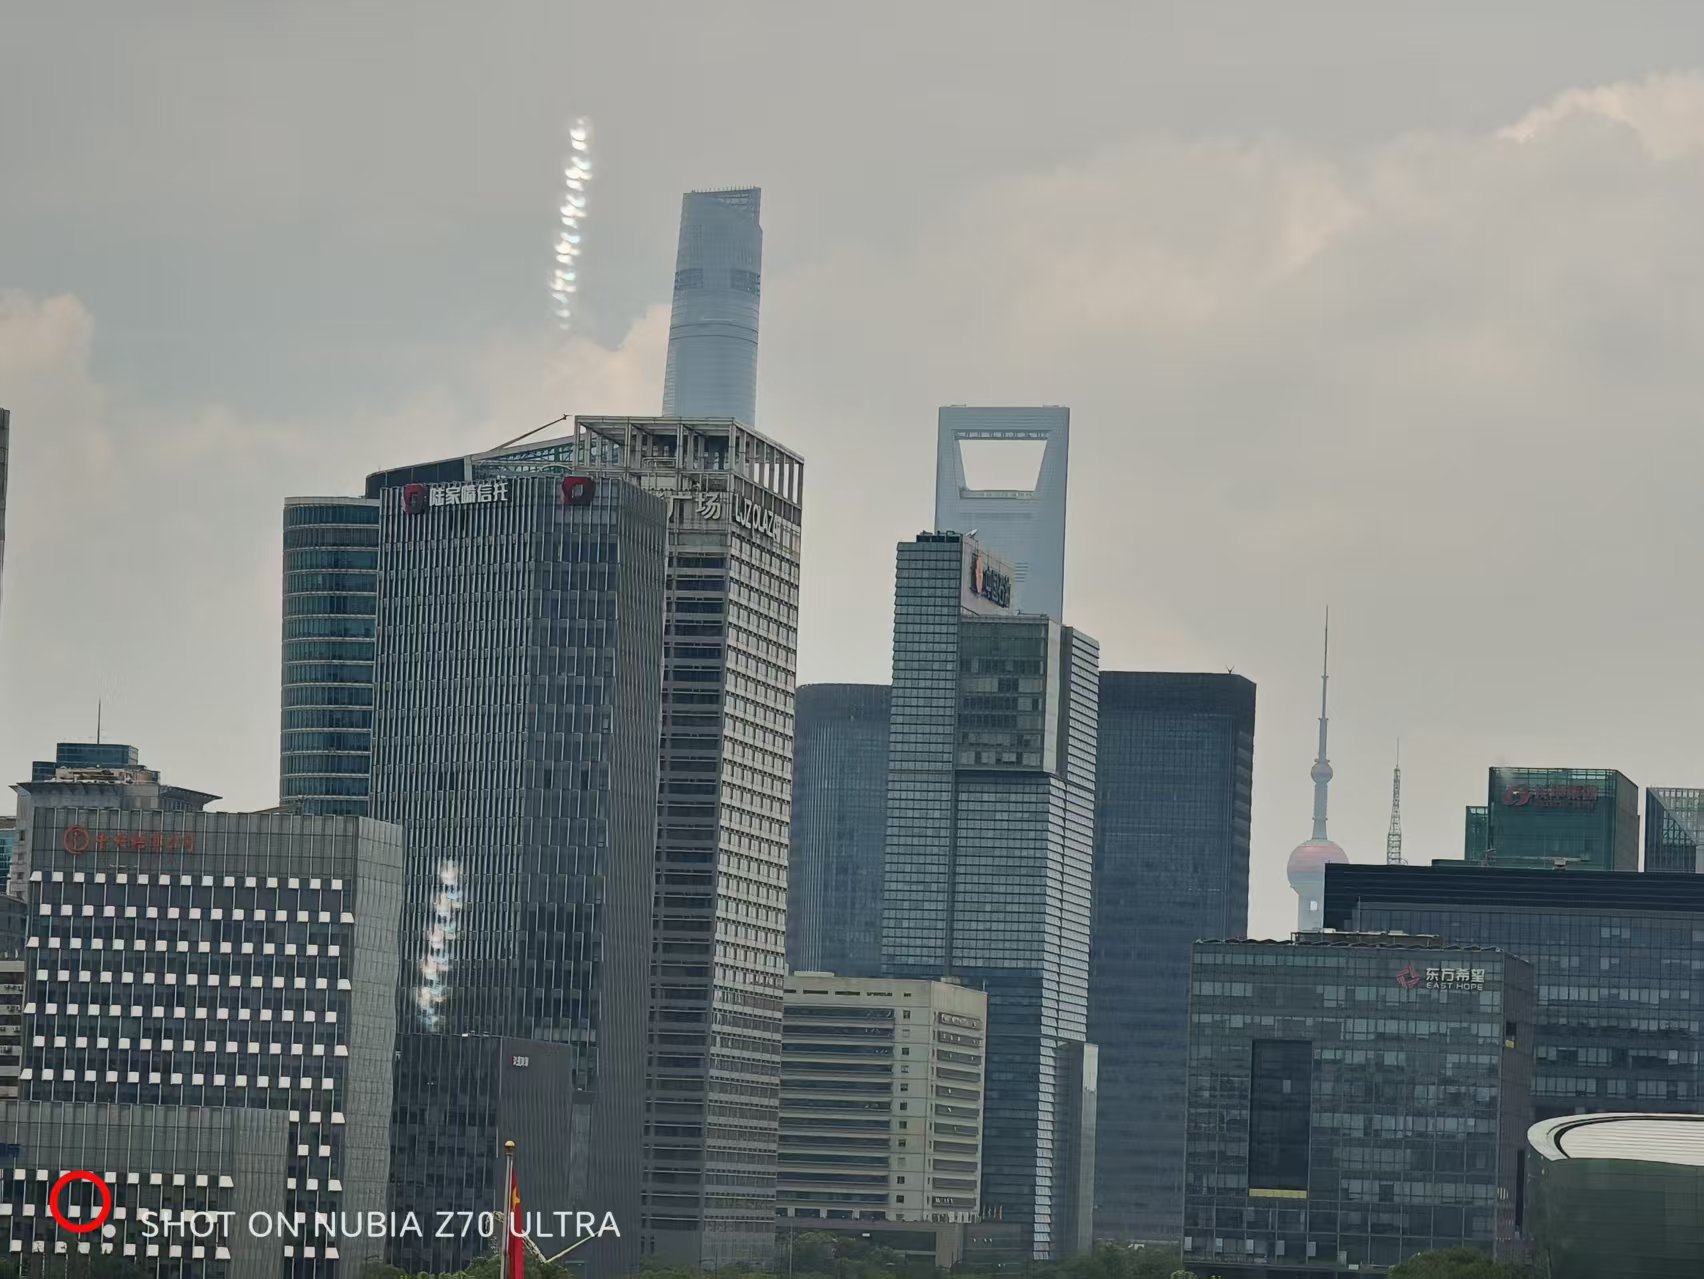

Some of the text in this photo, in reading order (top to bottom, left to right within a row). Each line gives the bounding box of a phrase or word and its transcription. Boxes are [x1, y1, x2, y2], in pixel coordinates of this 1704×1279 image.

[655, 490, 721, 520] 广场
[1426, 967, 1485, 983] 东方希望
[1426, 982, 1484, 991] EAST HOPE
